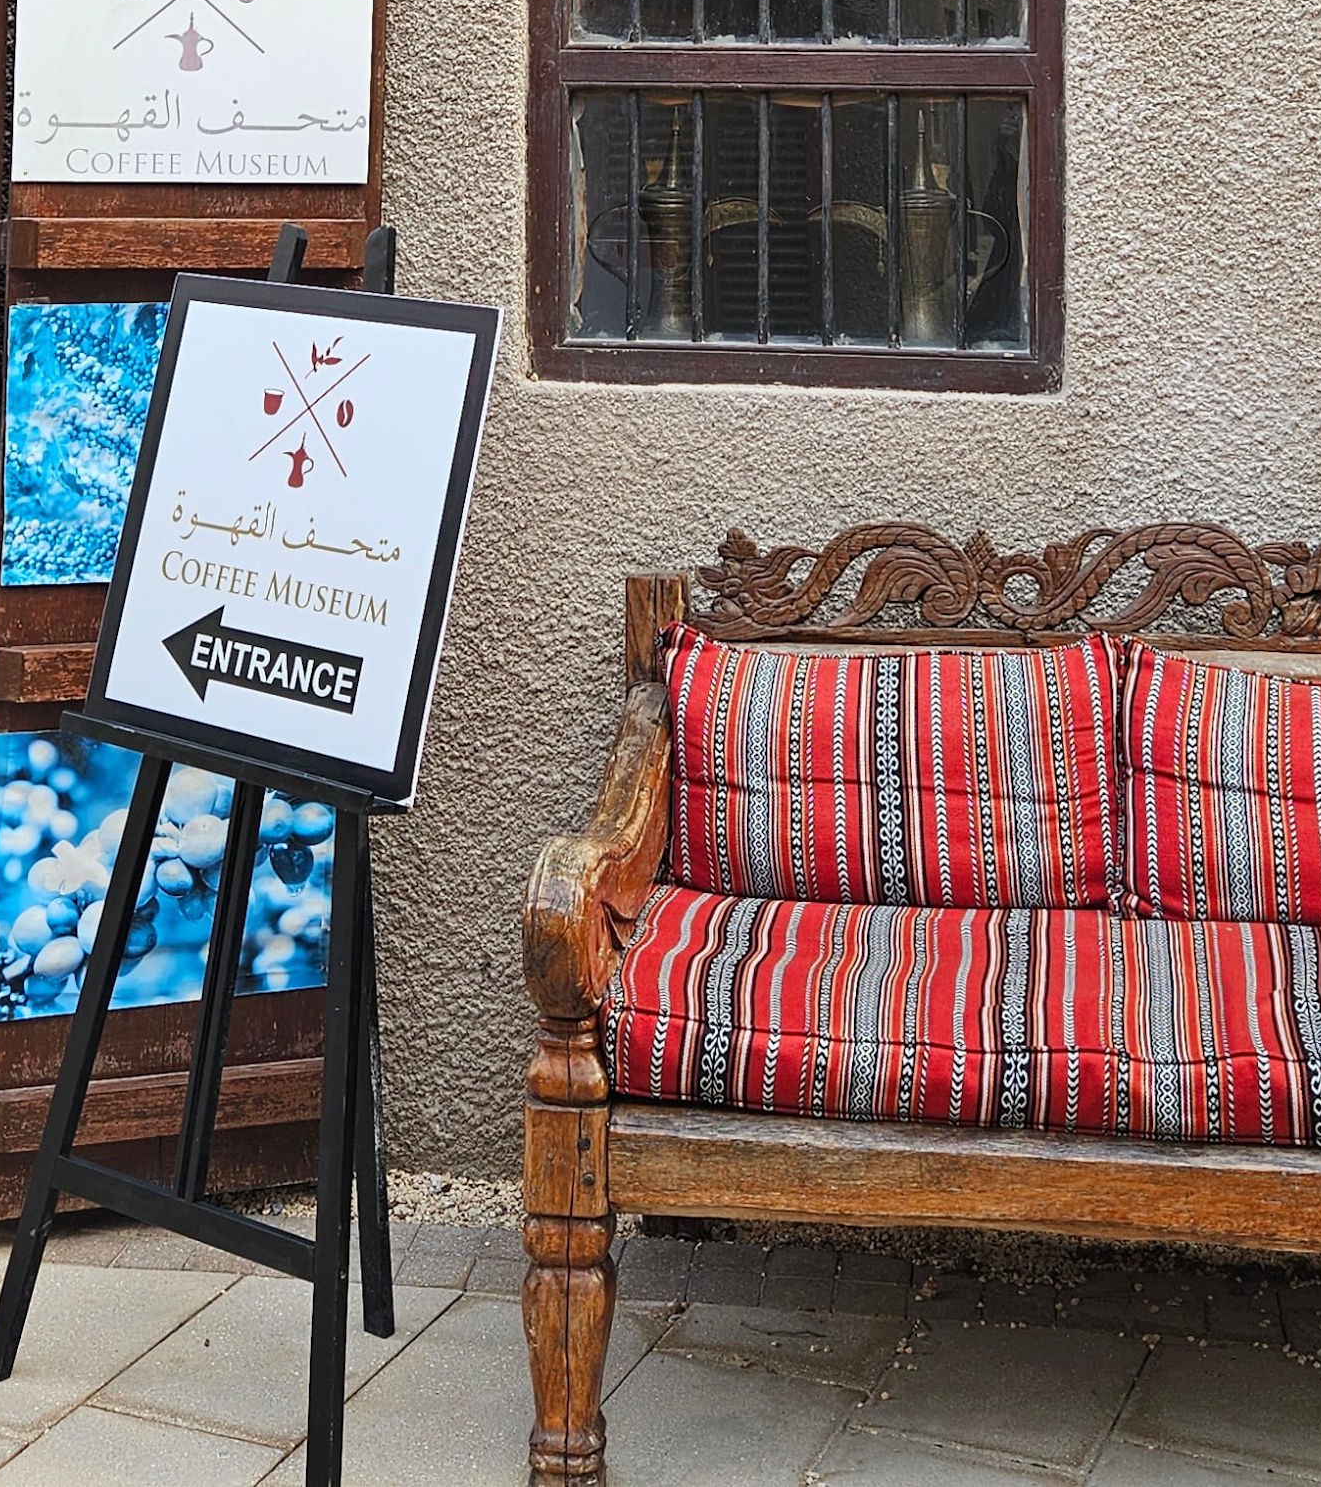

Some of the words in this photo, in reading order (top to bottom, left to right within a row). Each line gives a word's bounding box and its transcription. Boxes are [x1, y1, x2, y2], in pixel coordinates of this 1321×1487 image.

[15, 88, 181, 145] القهوة
[196, 97, 368, 135] متحف
[171, 489, 276, 548] القهوة
[281, 515, 402, 564] متحف
[189, 632, 358, 705] ENTRANCE
